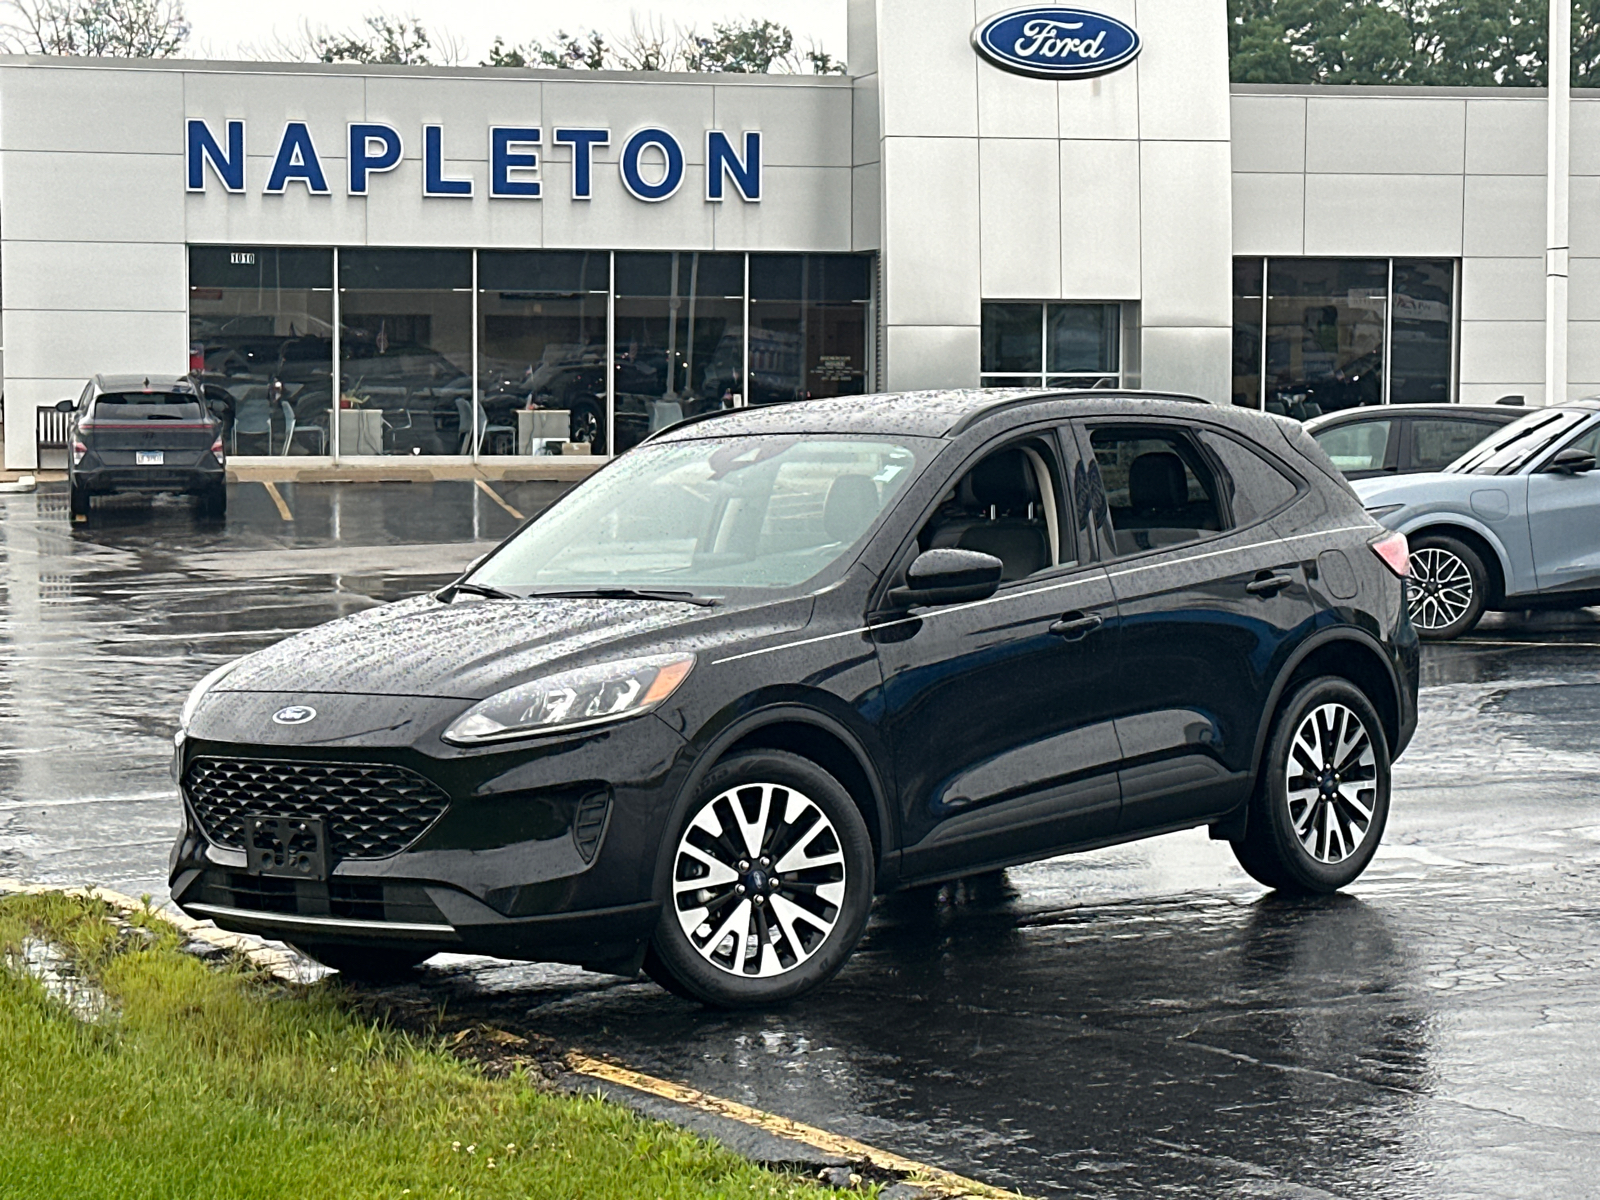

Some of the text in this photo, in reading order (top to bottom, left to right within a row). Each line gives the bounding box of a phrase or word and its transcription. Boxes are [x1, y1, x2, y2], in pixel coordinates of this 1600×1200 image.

[1014, 19, 1107, 58] Ford
[185, 118, 762, 203] NAPLETON
[232, 253, 254, 263] 1010
[280, 708, 306, 720] Ford
